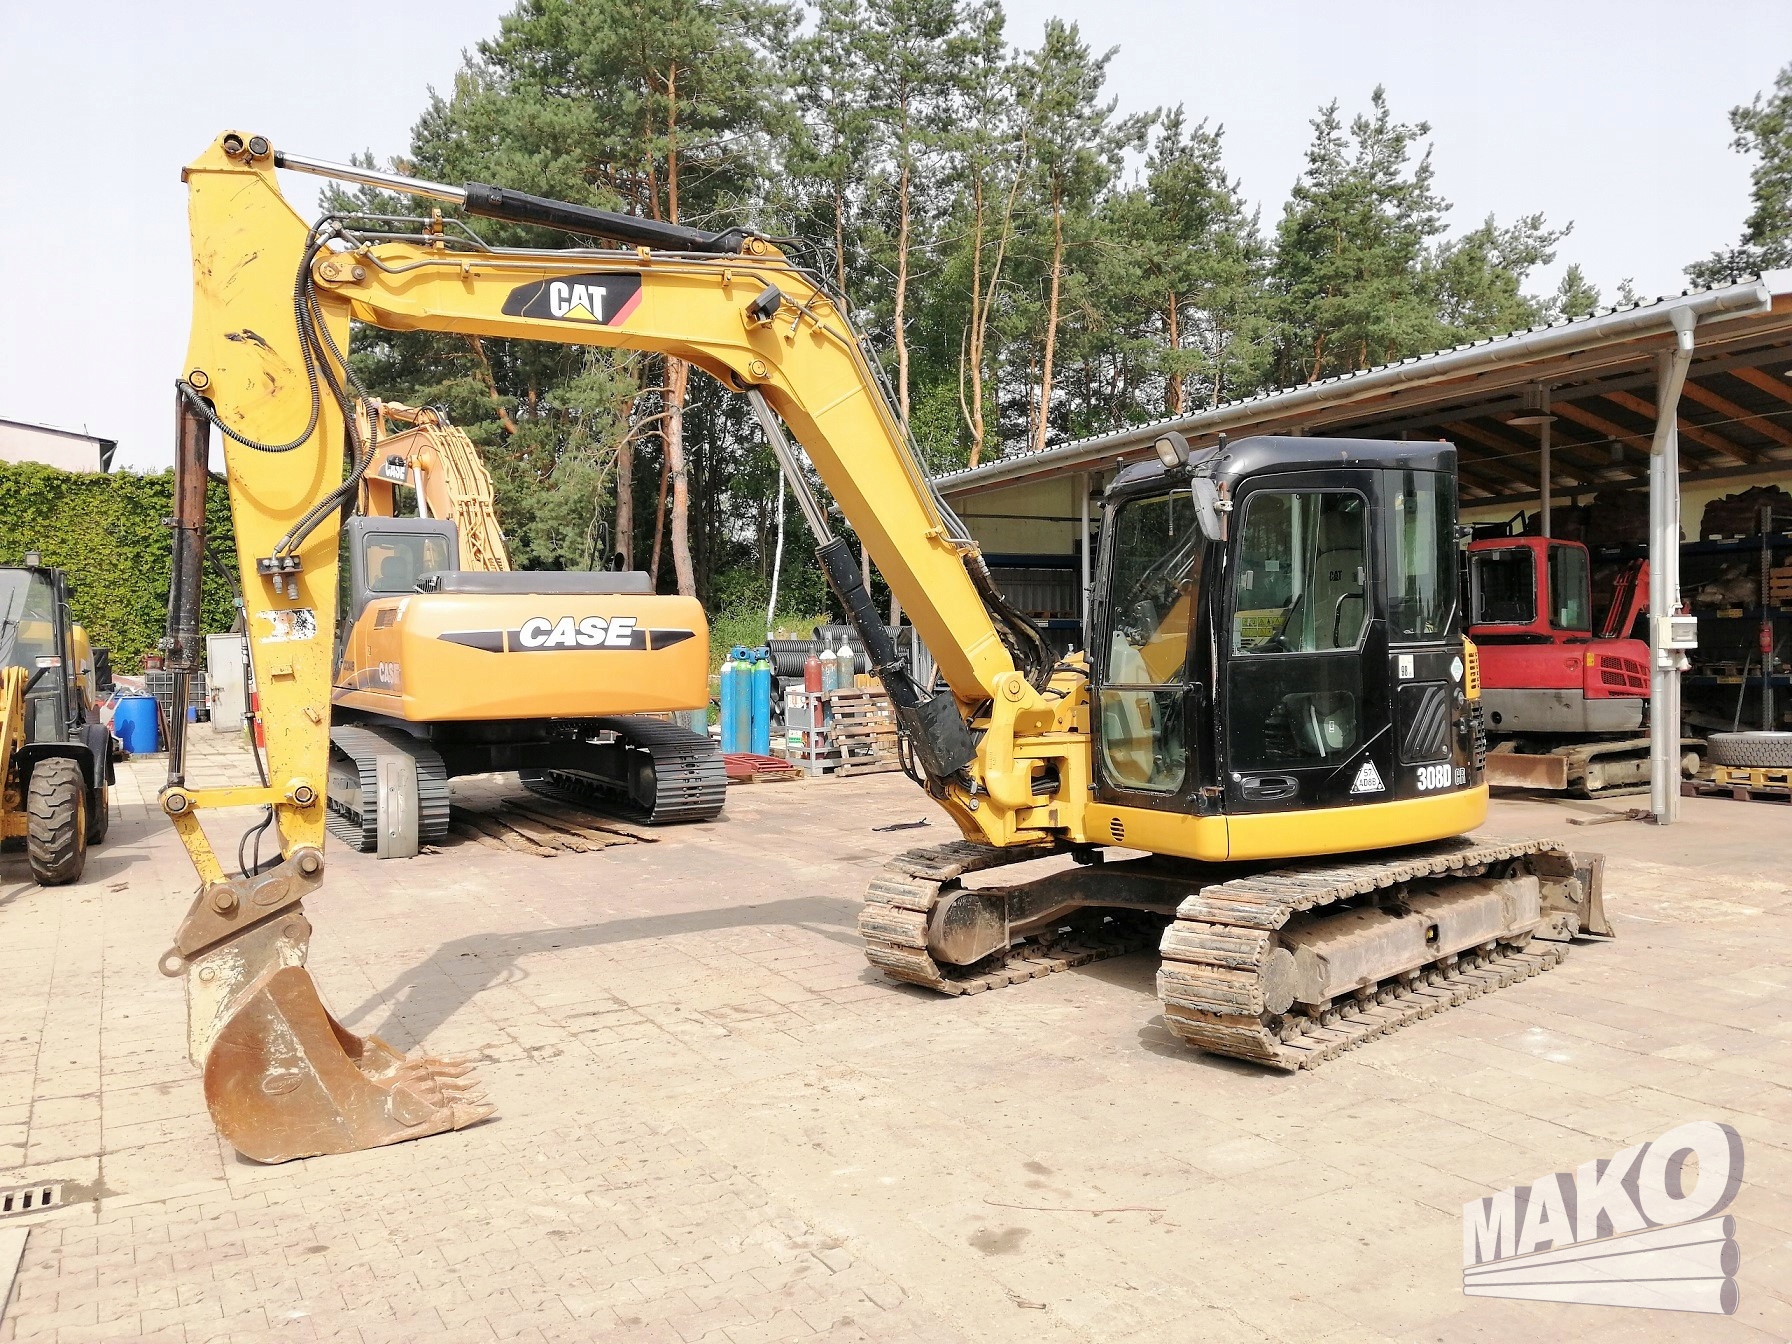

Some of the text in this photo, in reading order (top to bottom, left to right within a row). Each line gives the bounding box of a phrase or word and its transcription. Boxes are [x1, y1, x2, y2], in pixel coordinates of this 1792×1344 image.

[549, 281, 607, 321] CAT
[385, 460, 406, 480] CASE
[1329, 570, 1343, 582] CAT
[519, 615, 638, 648] CASE
[379, 660, 400, 684] CASE
[1417, 764, 1452, 791] 308D
